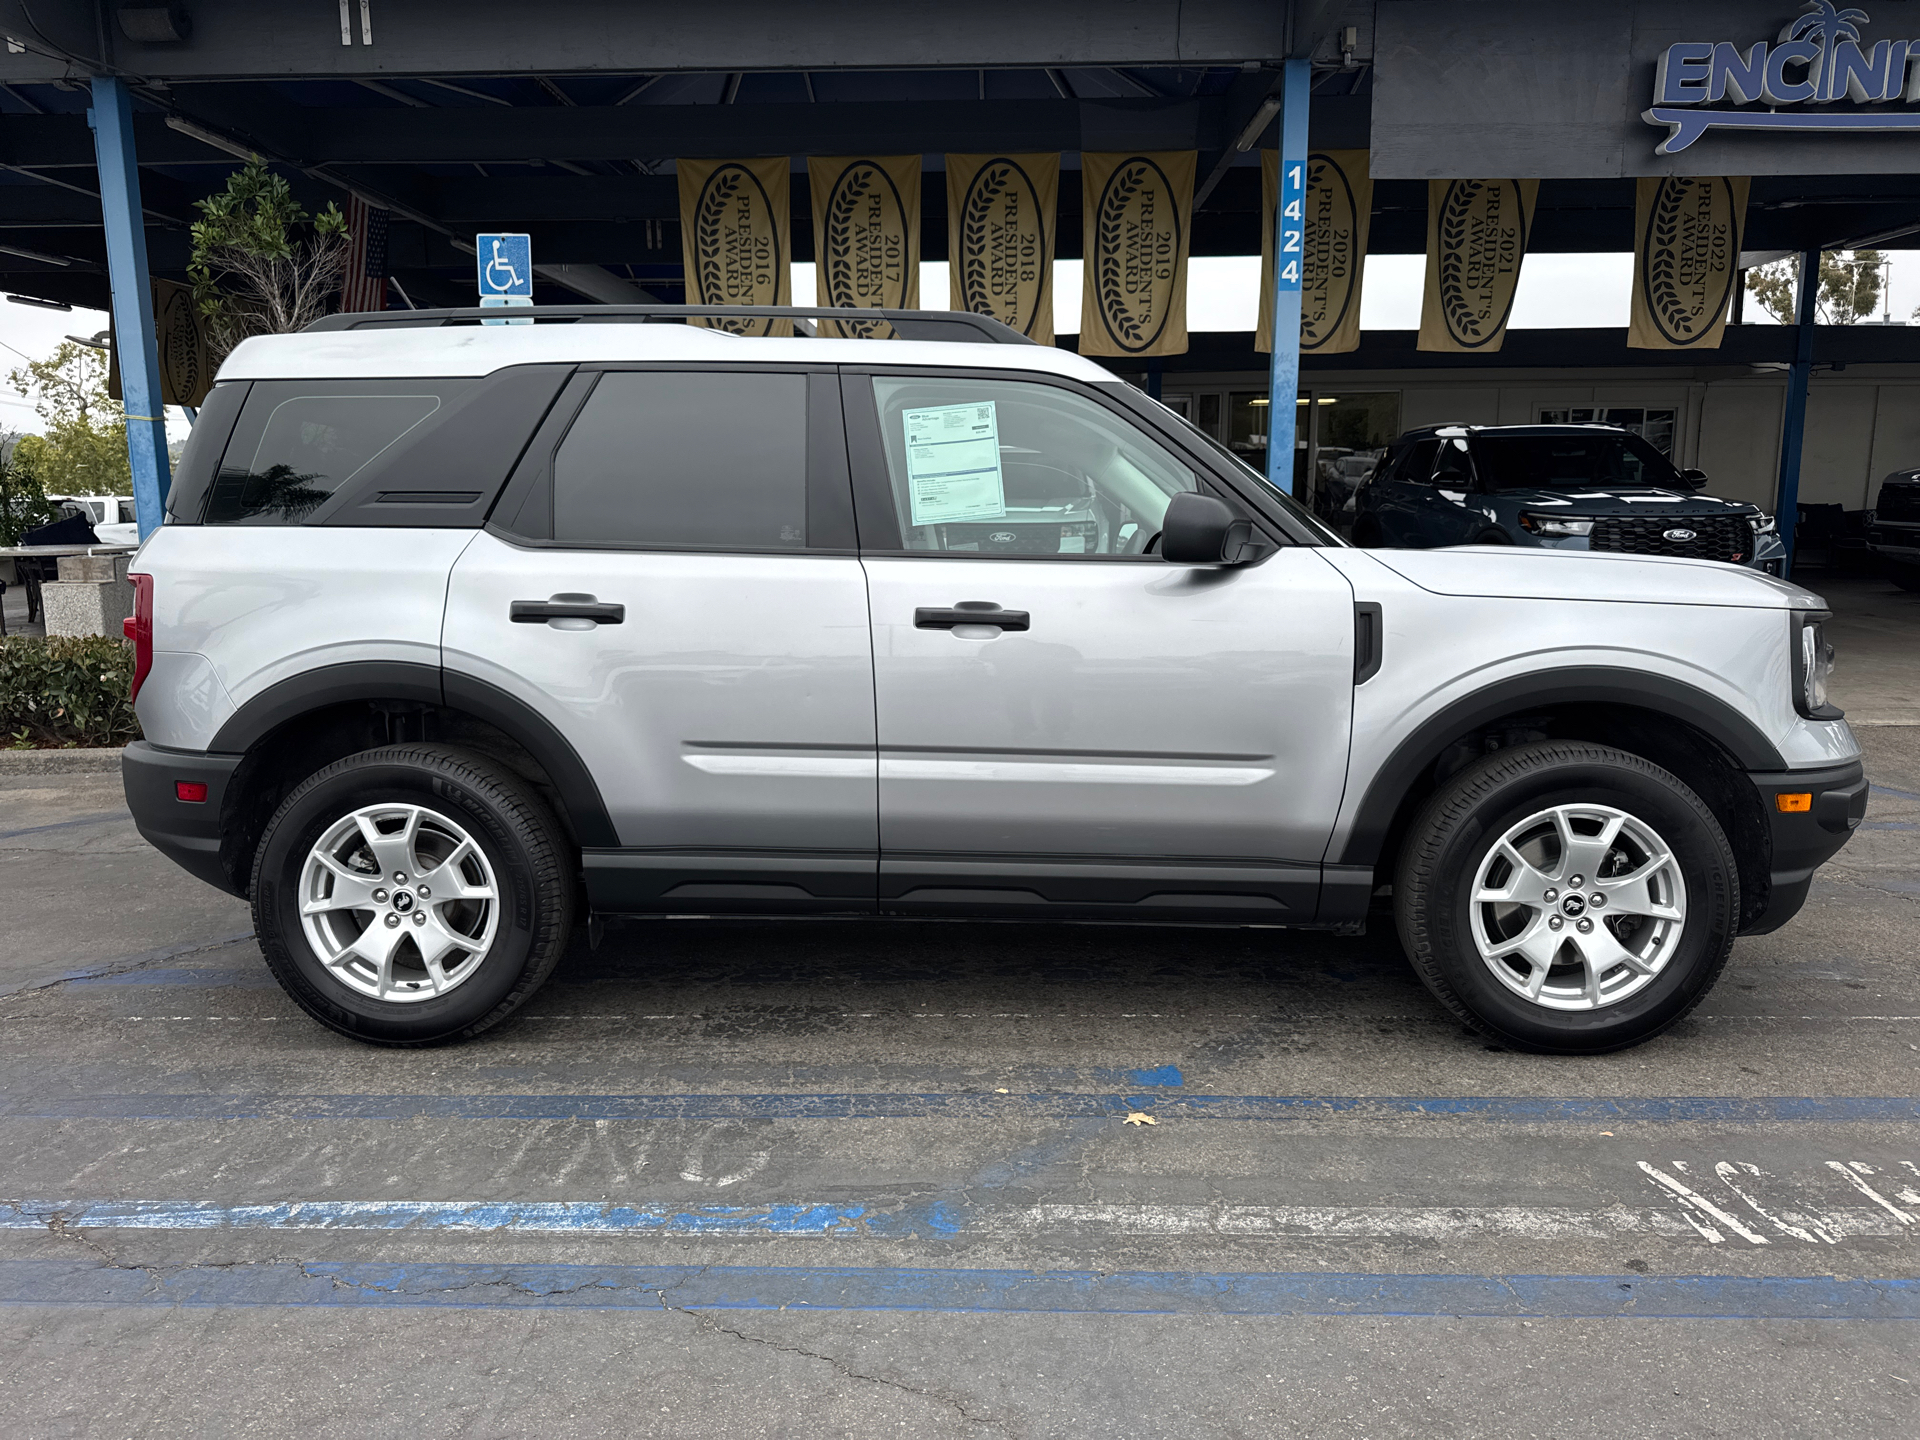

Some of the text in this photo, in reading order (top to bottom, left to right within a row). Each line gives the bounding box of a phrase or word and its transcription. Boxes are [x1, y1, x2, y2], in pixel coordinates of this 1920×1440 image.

[755, 236, 771, 285] 2016
[855, 223, 870, 297] AWARD
[885, 234, 900, 282] 2017
[990, 222, 1004, 296] AWARD
[1004, 191, 1018, 326] PRESIDENT'S
[1020, 234, 1036, 282] 2018
[1125, 220, 1139, 295] AWARD
[1138, 189, 1154, 324] PRESIDENT'S
[1155, 232, 1171, 280] 2019
[1281, 165, 1302, 283] 1424
[1302, 219, 1317, 291] AWARD
[1313, 187, 1333, 321] PRESIDENT'S
[1331, 229, 1349, 278] 2020
[1466, 216, 1485, 290] AWARD
[1478, 185, 1501, 320] PRESIDENT'S
[1498, 227, 1515, 275] 2021
[1679, 213, 1696, 286] AWARD
[1691, 182, 1712, 316] PRESIDENT'S
[1709, 223, 1727, 272] 2022
[725, 225, 740, 298] AWARD
[462, 799, 519, 861] MICHELIN
[1705, 852, 1725, 930] MICHELIN
